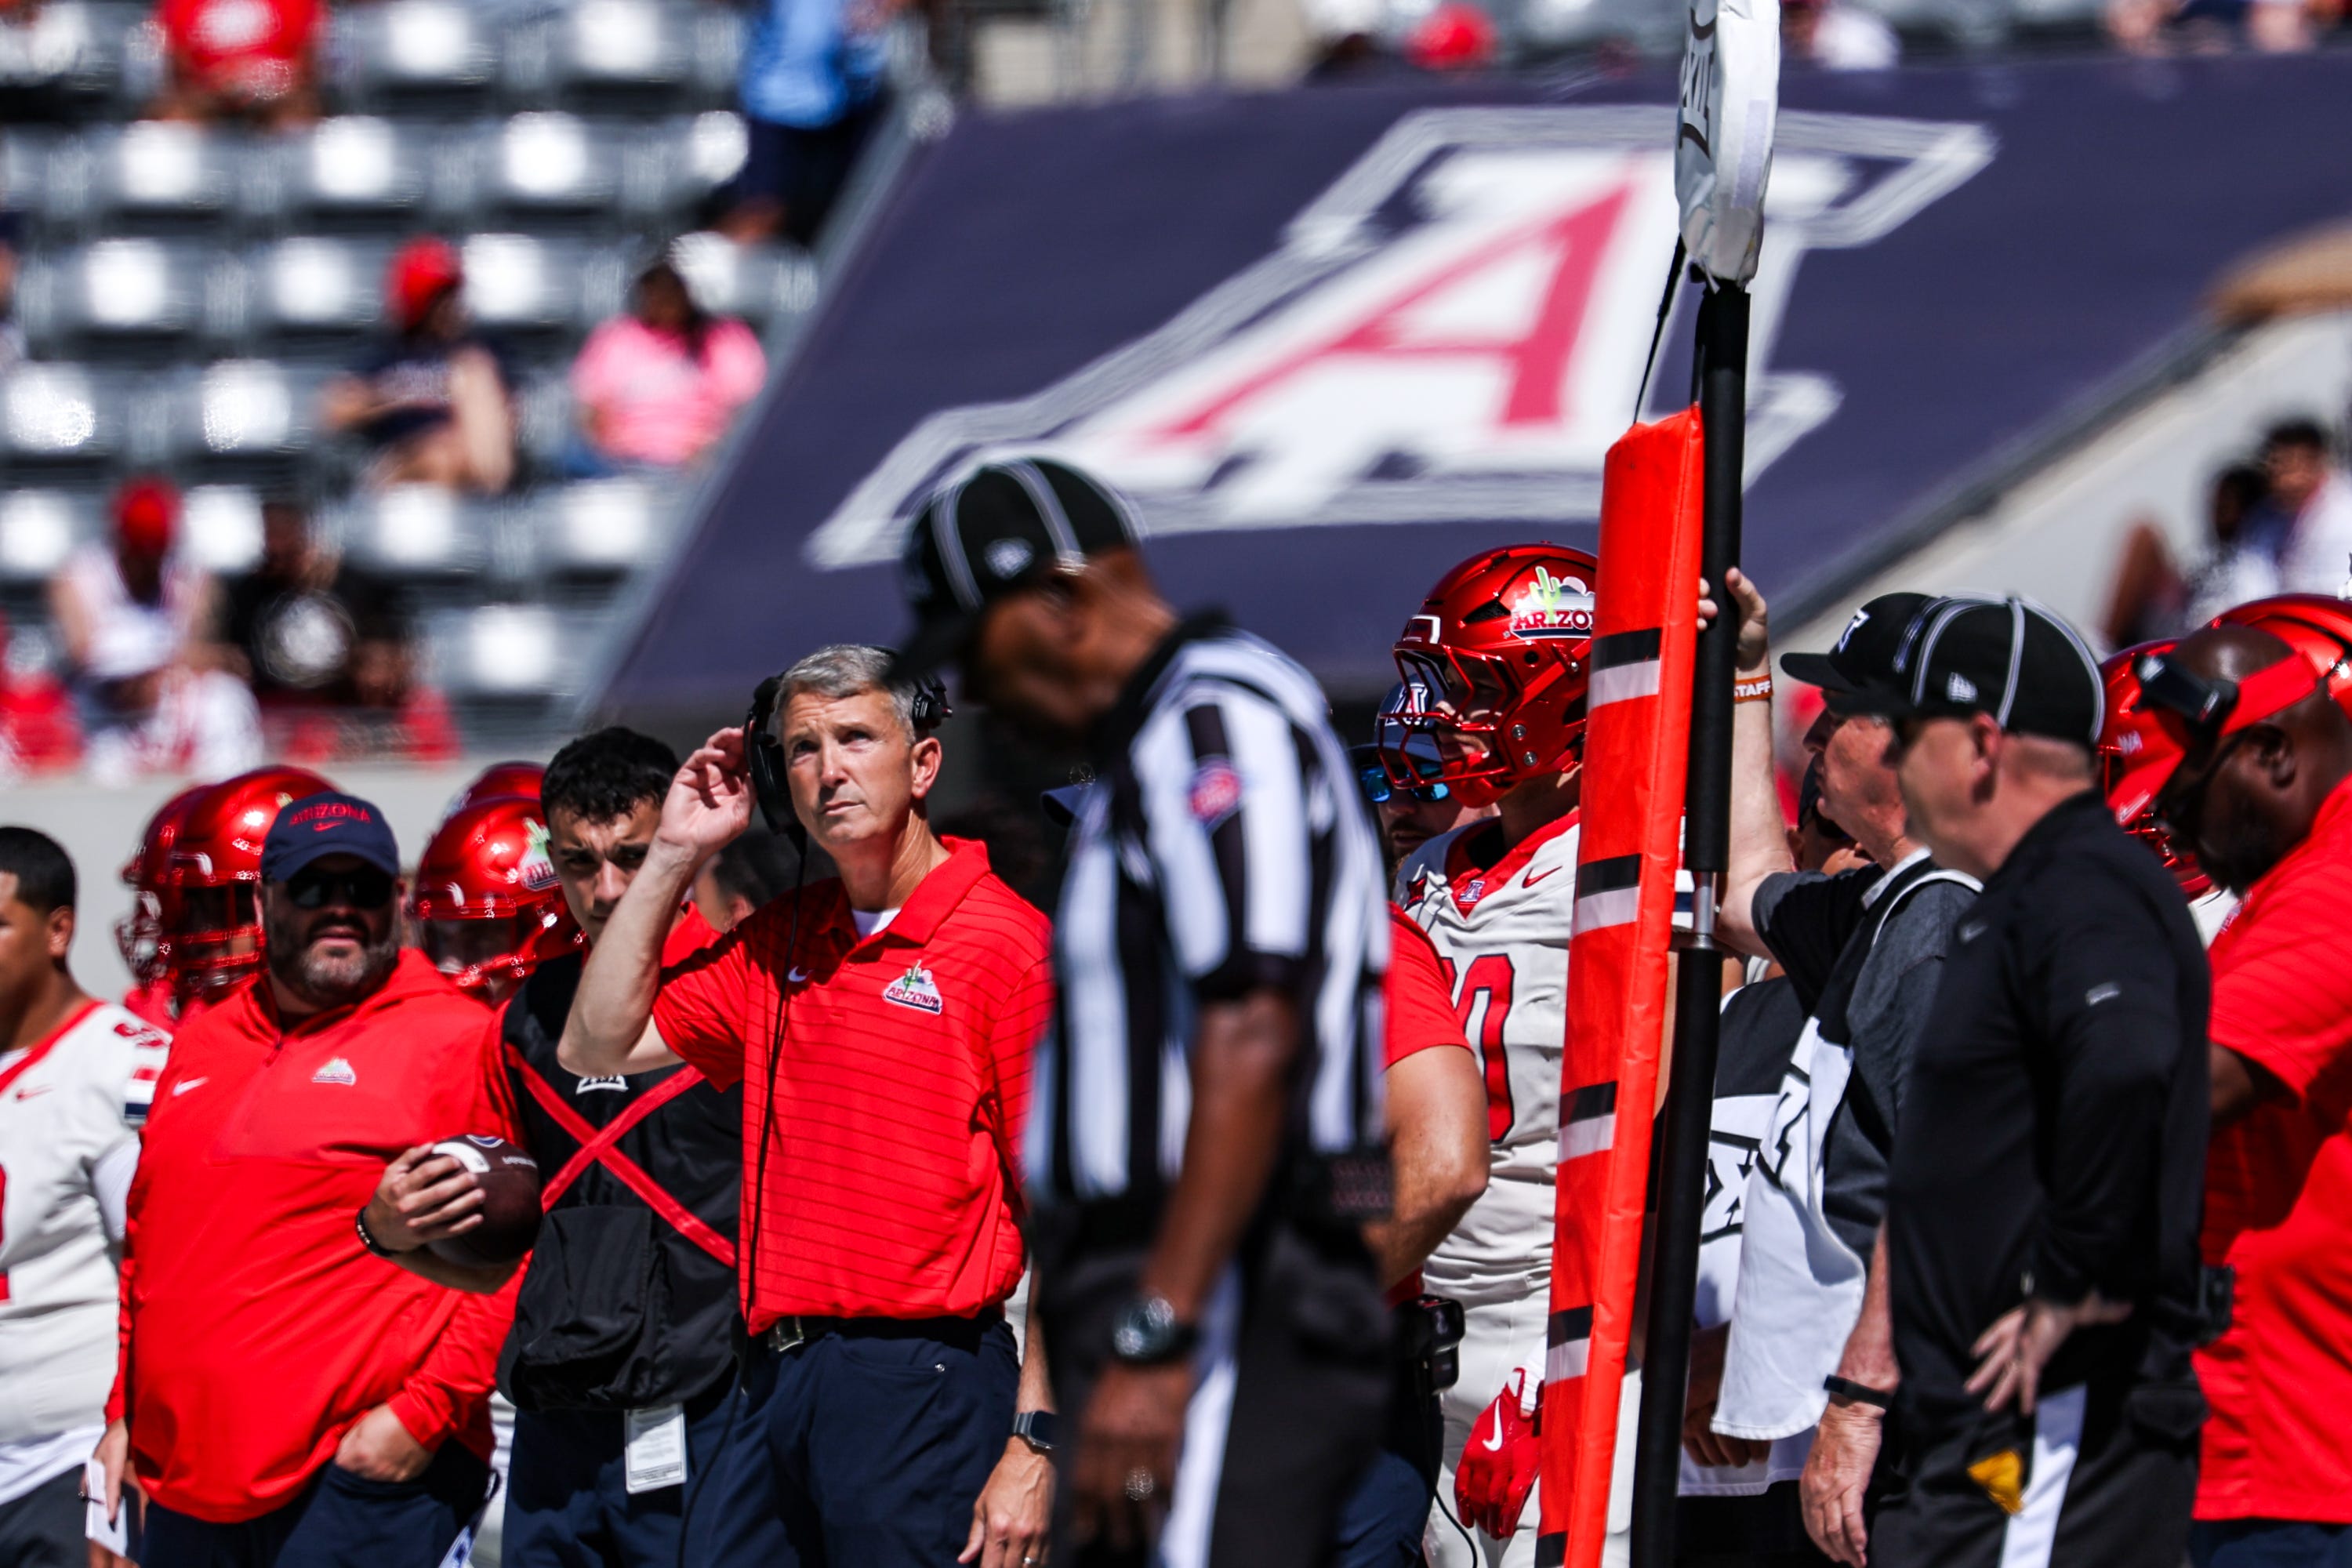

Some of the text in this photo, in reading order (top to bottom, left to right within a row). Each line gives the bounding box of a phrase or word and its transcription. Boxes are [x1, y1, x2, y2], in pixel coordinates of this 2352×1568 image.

[804, 106, 1998, 570] A
[1512, 610, 1594, 630] ARIZO
[887, 986, 938, 1008] ARIZONA
